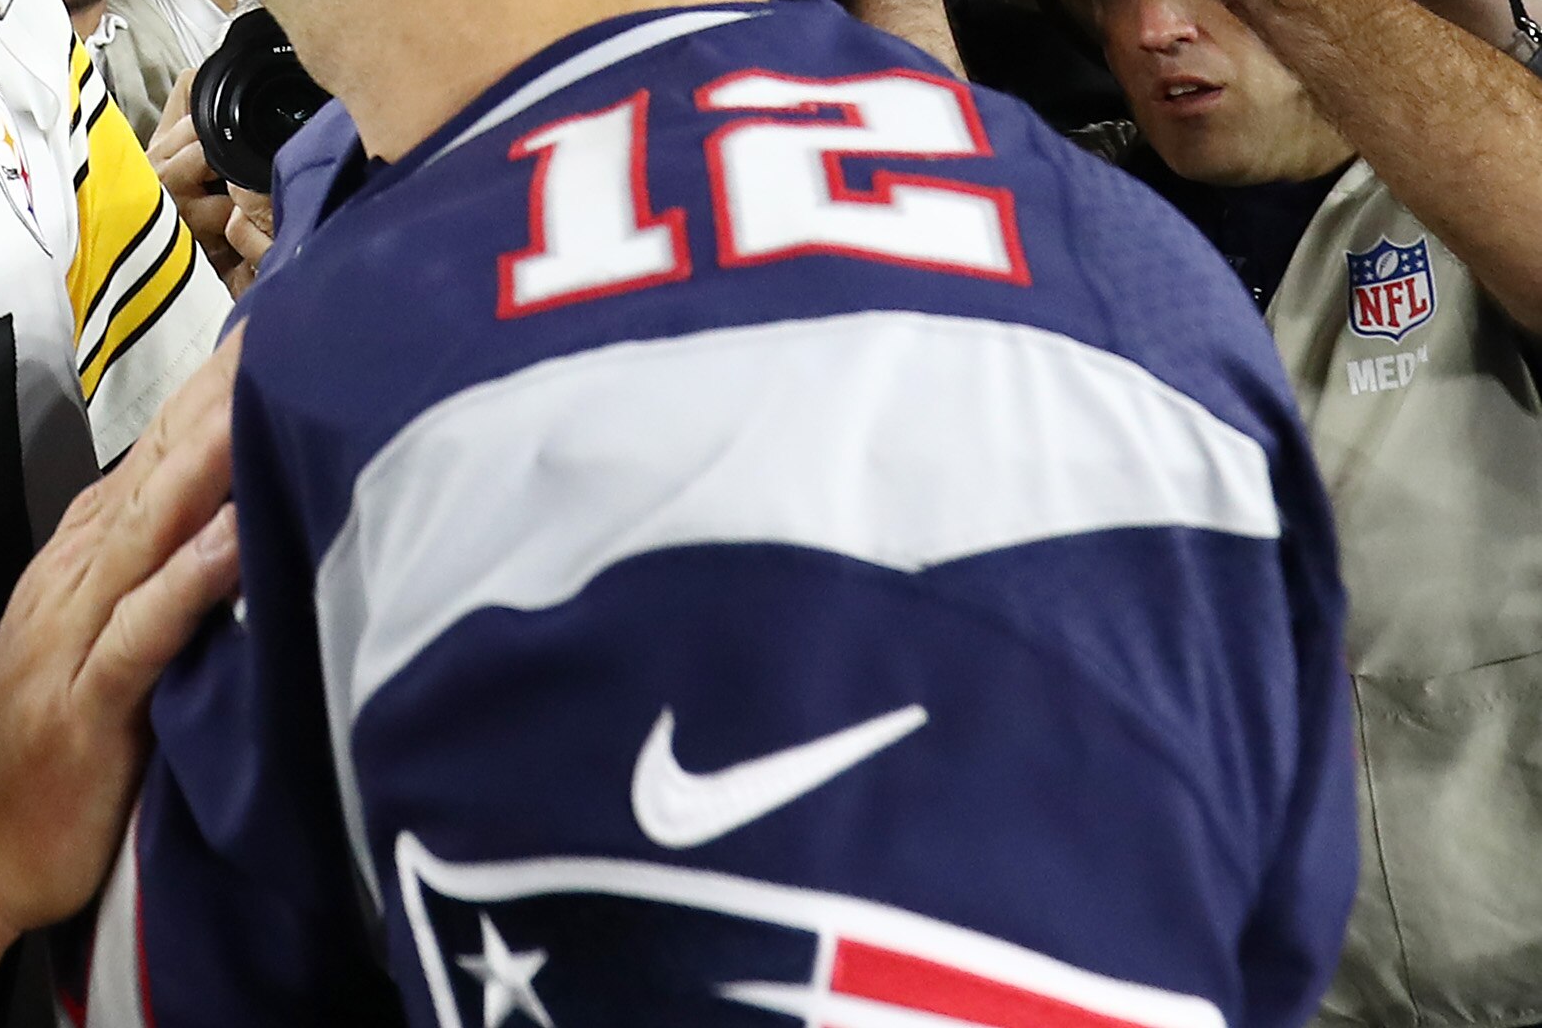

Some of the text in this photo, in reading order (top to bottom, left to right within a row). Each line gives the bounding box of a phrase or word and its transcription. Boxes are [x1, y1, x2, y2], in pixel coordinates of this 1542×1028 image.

[495, 68, 1032, 319] 12
[1356, 277, 1427, 328] NFL
[1347, 345, 1429, 396] MED
